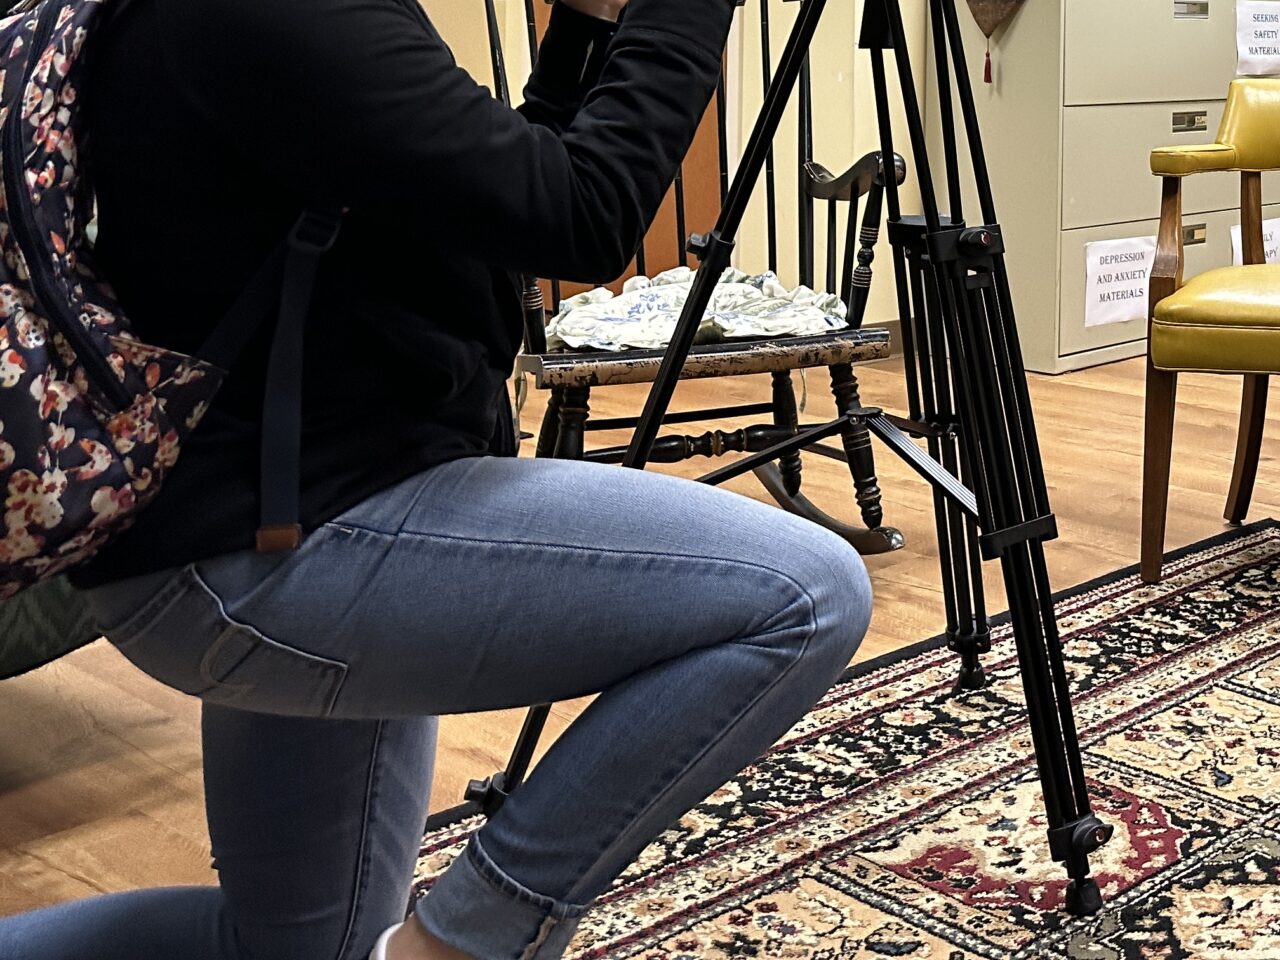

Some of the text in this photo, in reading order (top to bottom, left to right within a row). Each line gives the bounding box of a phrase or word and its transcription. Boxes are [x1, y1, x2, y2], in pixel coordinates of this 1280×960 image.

[1252, 13, 1279, 23] SEEKING
[1253, 28, 1279, 39] SAFETY
[1099, 251, 1145, 266] DEPRESSION
[1097, 267, 1148, 285] AND ANXIETY
[1099, 288, 1144, 303] MATERIALS
